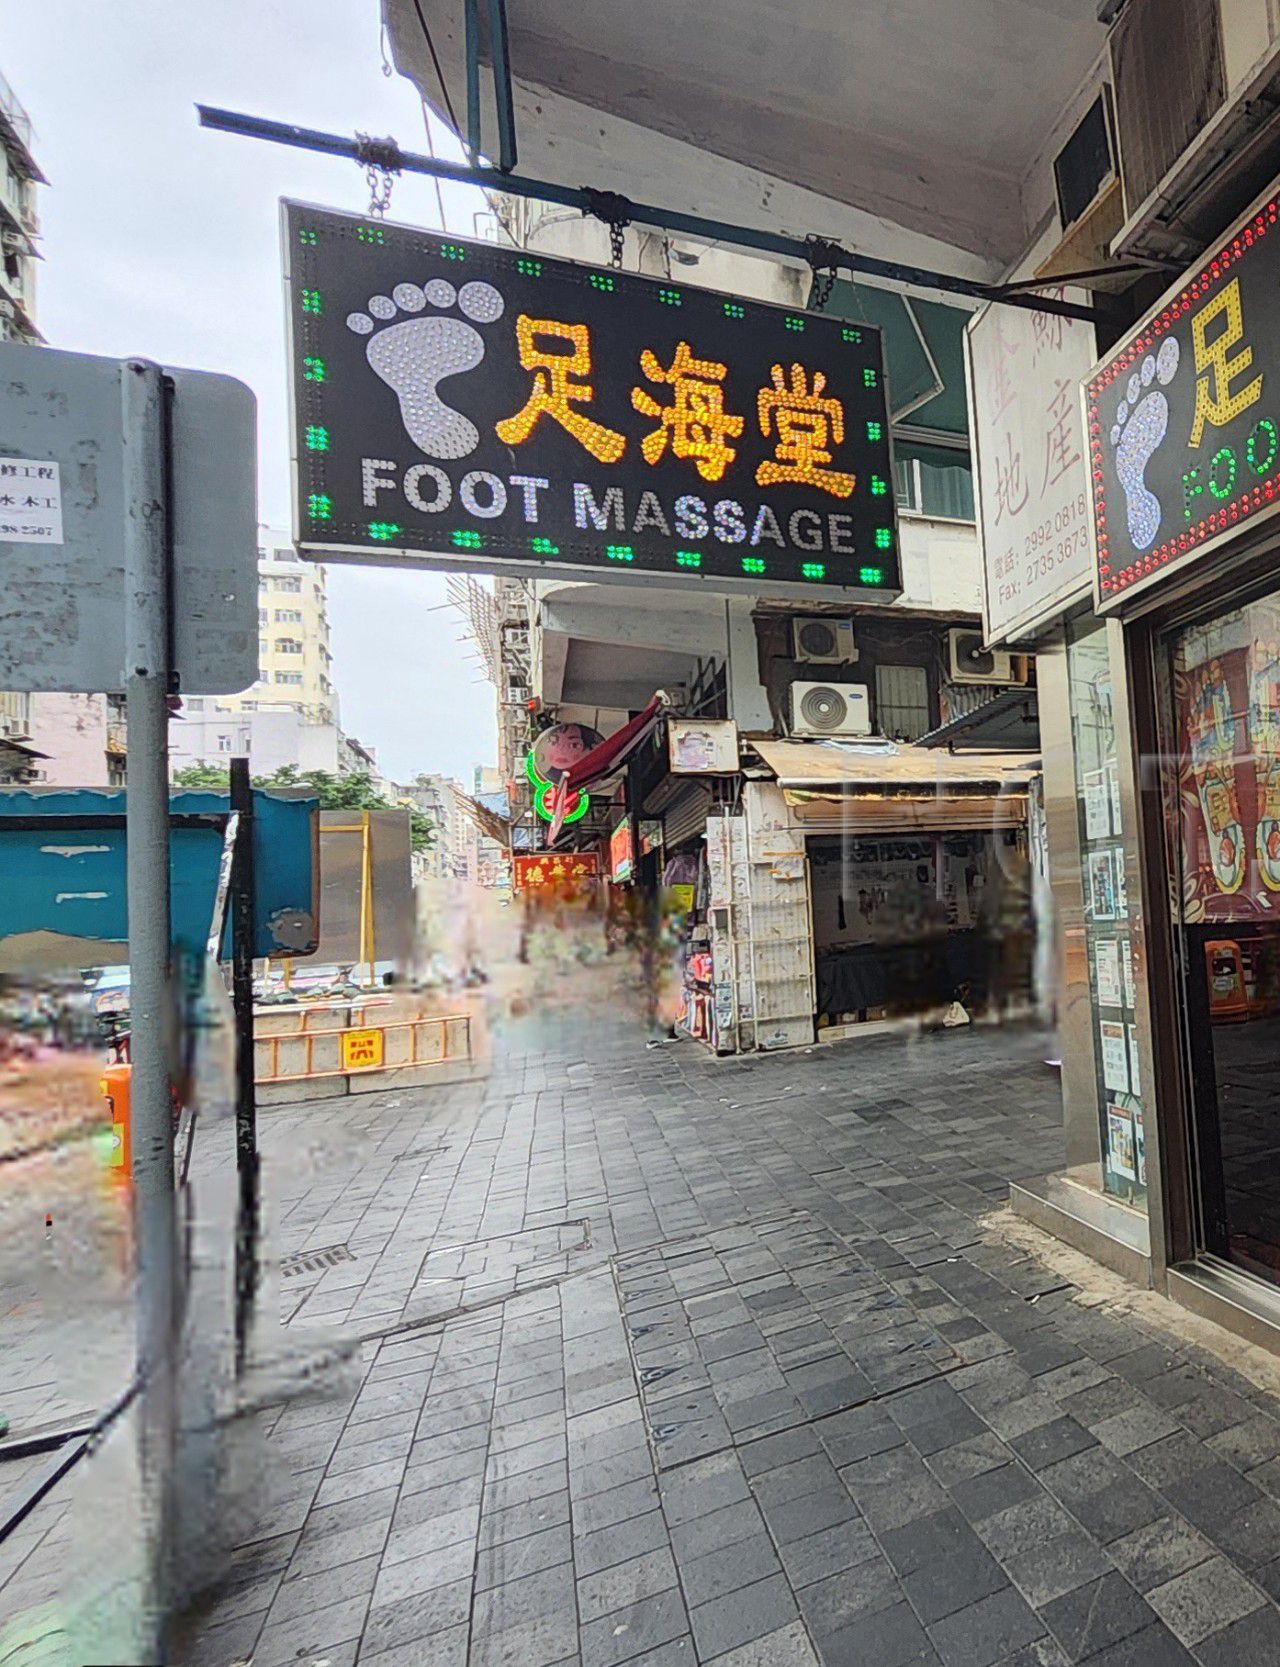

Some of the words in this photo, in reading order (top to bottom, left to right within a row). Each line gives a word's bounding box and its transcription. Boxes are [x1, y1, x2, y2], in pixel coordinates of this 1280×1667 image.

[496, 314, 857, 500] 足海堂
[362, 458, 549, 523] FOOT
[573, 480, 856, 555] MASSAGE
[1024, 518, 1052, 557] 2992
[1054, 492, 1087, 533] 0818
[1026, 553, 1054, 587] 2735
[1057, 526, 1088, 562] 3673
